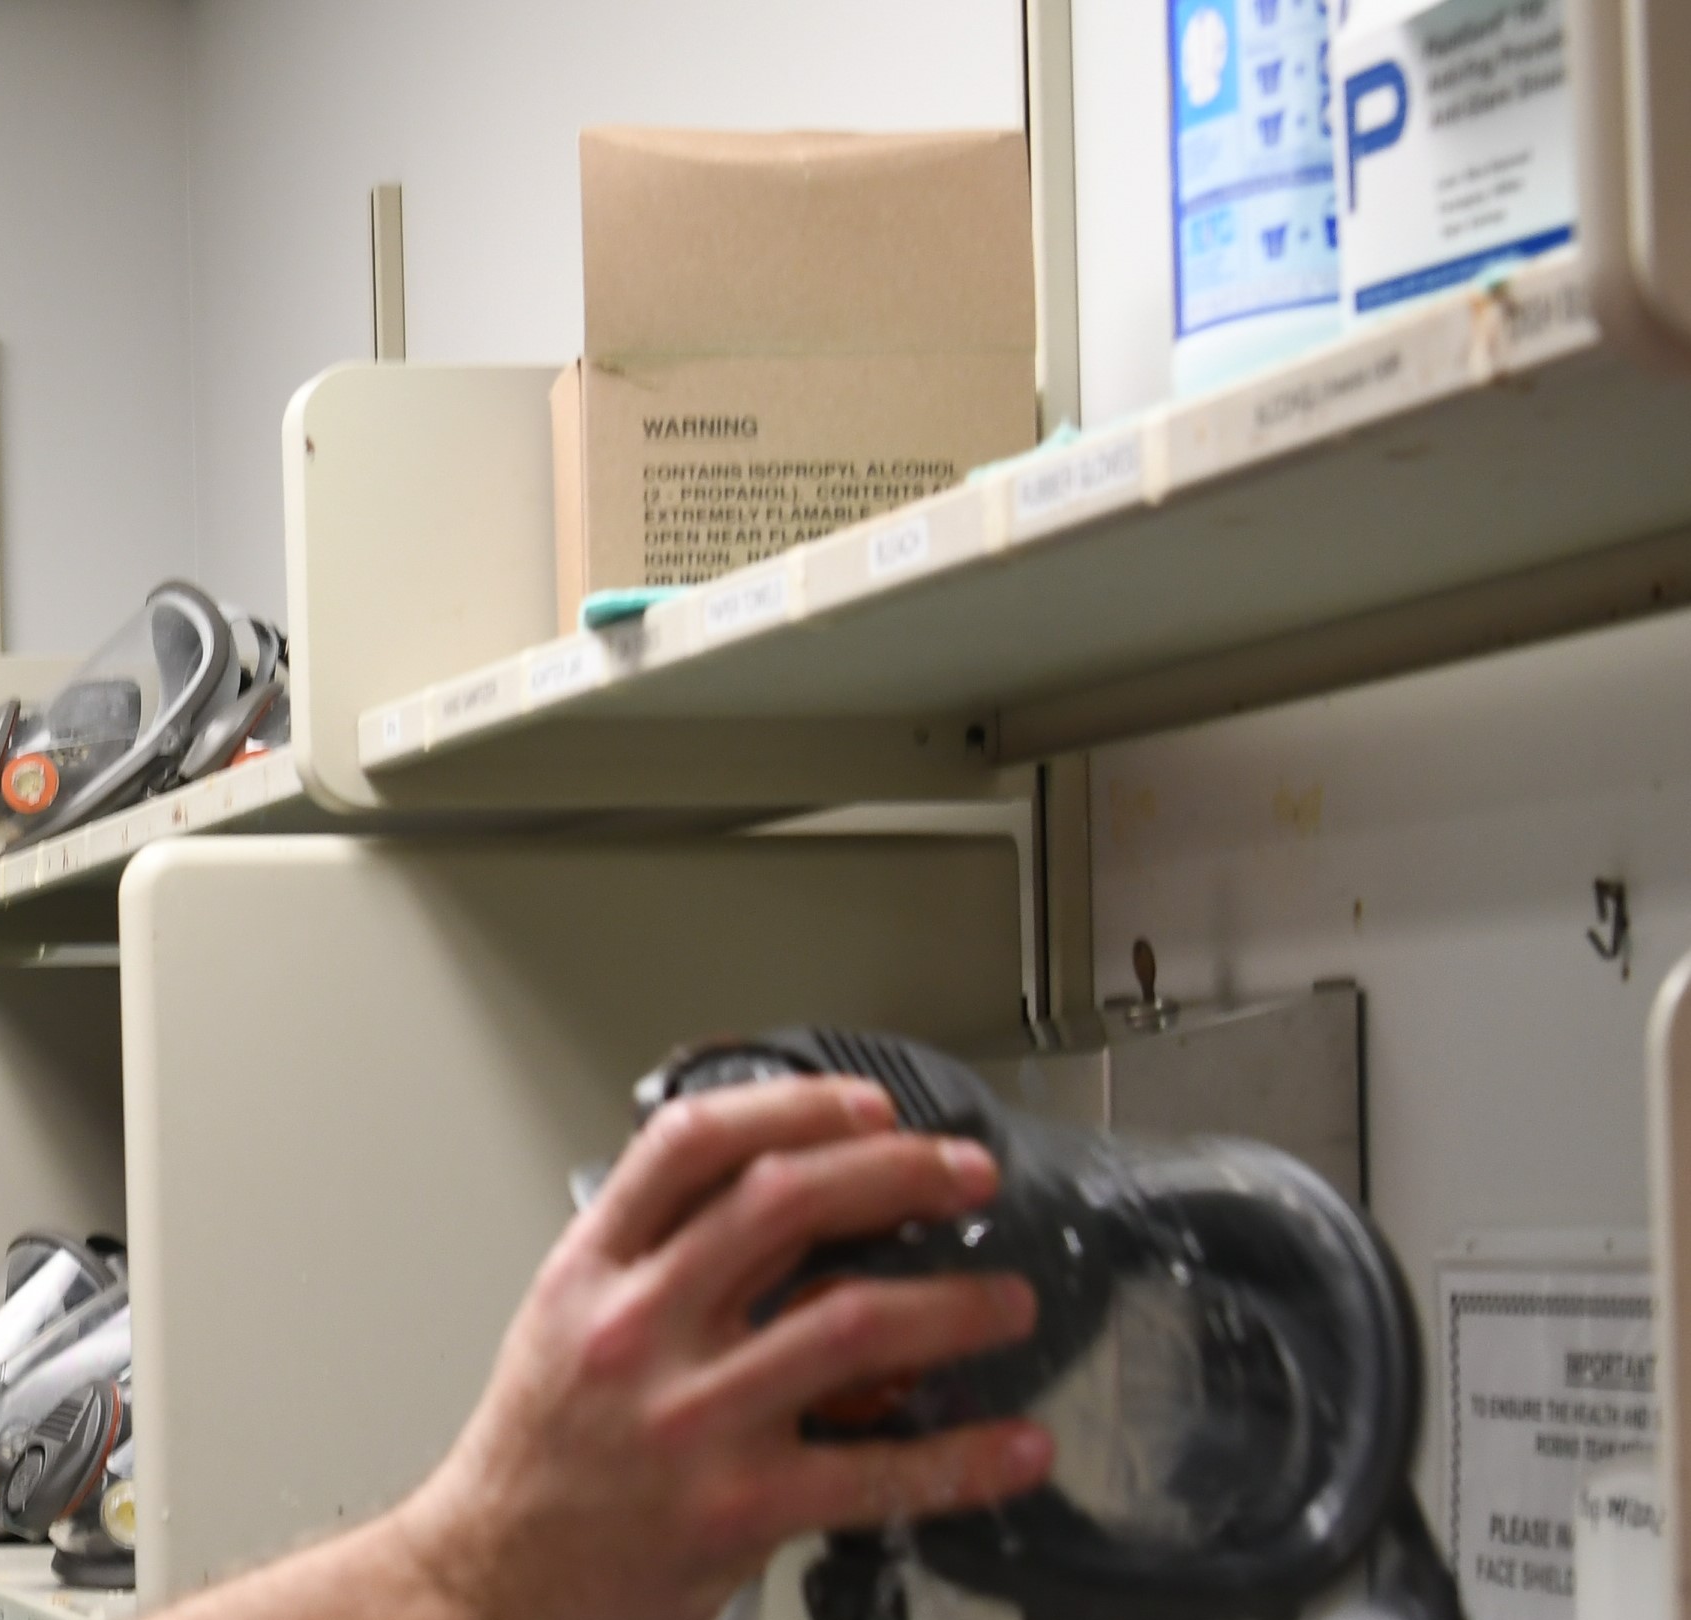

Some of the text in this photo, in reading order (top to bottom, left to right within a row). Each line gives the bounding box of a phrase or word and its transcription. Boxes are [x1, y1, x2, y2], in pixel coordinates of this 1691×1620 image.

[643, 416, 758, 440] WARNING
[643, 459, 955, 481] CONTAINS ISOPROPYL ALCOHOL
[816, 483, 924, 500] CONTENTS
[644, 507, 760, 525] EXTREMELY
[644, 529, 700, 546] OPEN
[707, 528, 763, 545] NEAR
[1489, 1513, 1550, 1549] PLEASE
[1475, 1555, 1517, 1589] FACE
